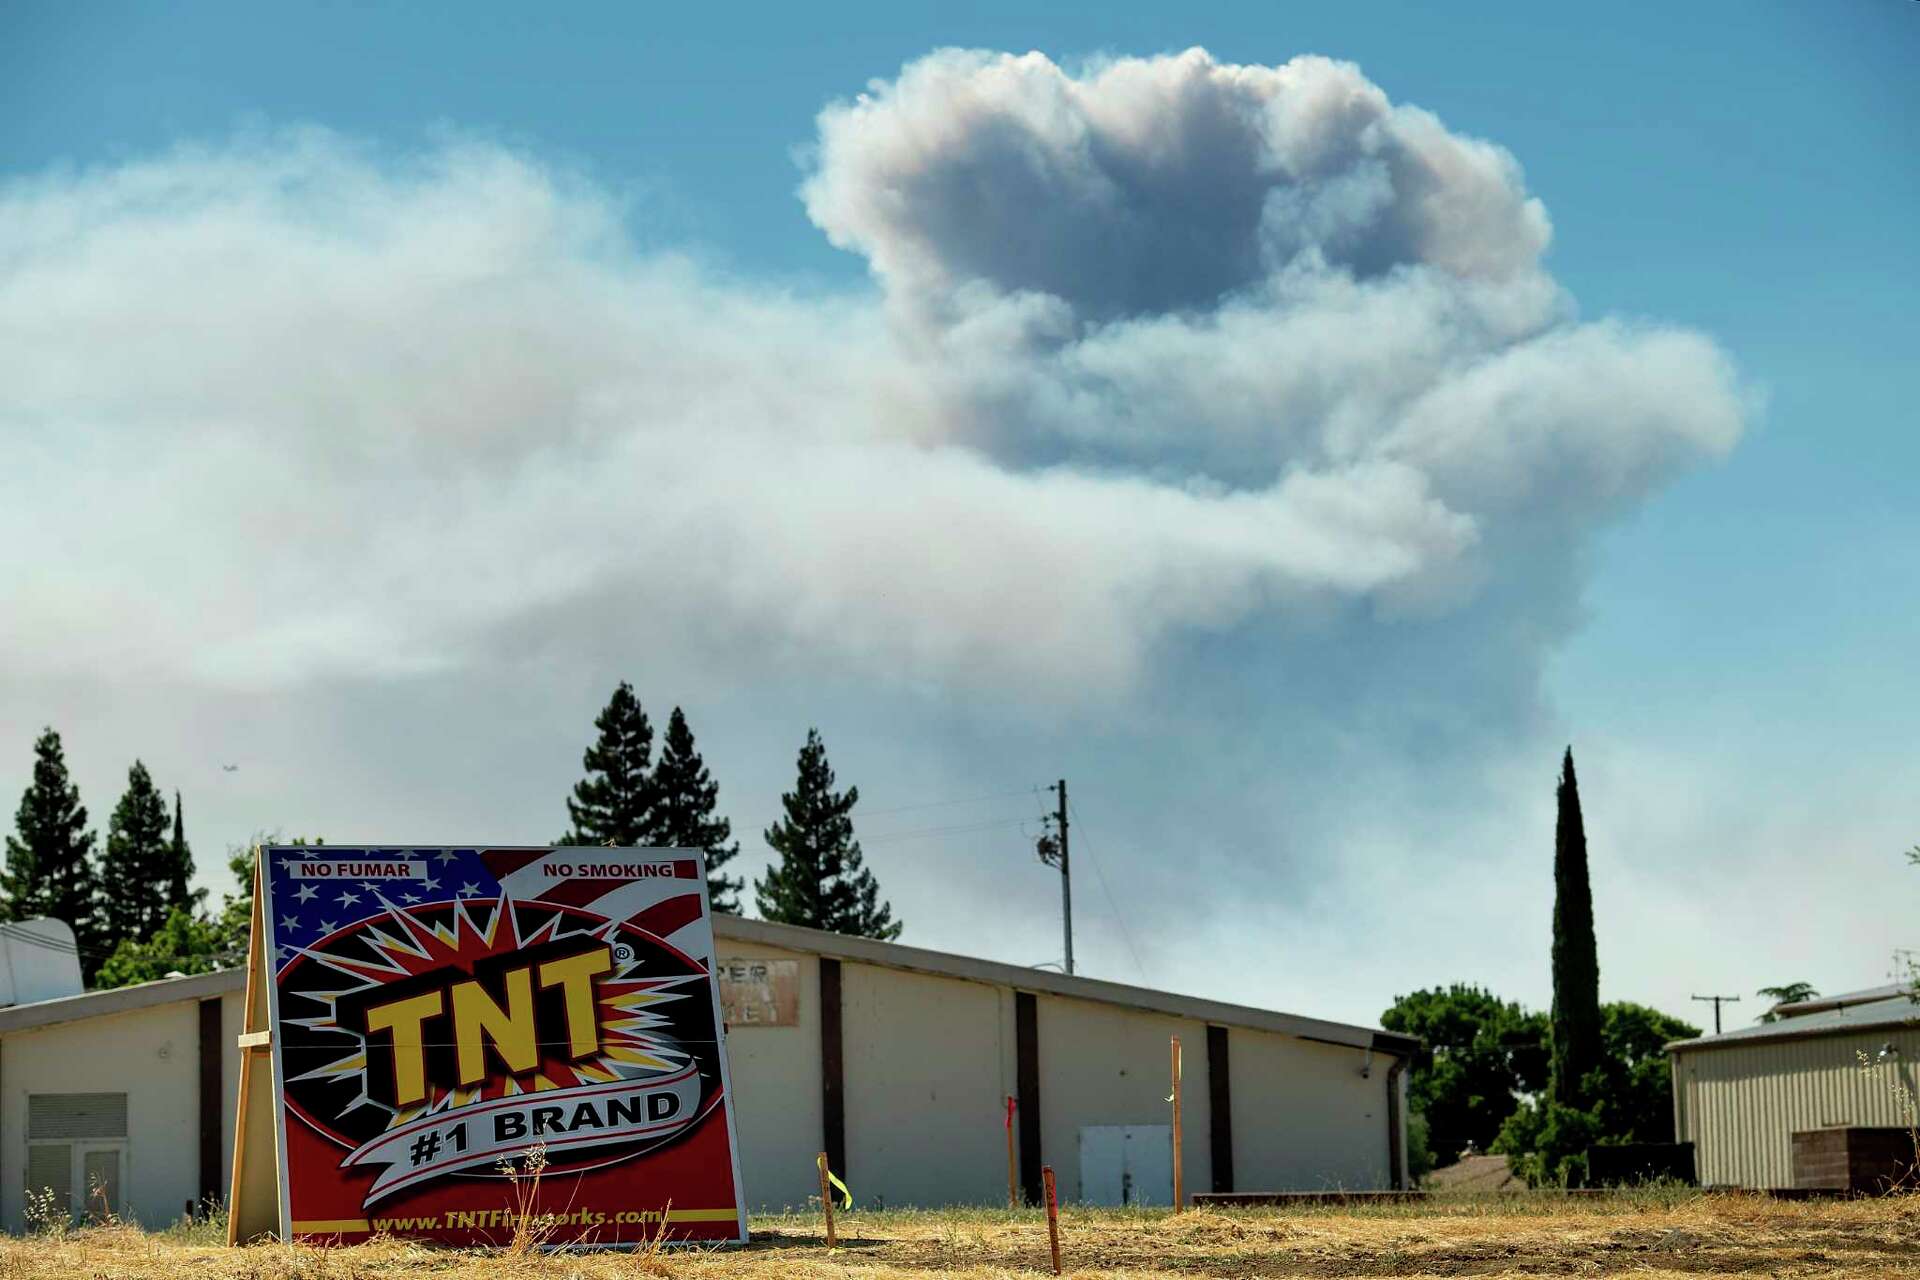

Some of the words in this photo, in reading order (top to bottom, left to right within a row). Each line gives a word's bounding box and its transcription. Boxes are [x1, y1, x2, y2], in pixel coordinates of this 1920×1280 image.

[301, 863, 332, 877] NO
[337, 863, 411, 877] FUMAR
[543, 863, 573, 877] NO
[578, 864, 673, 878] SMOKING
[365, 946, 614, 1107] TNT
[410, 1122, 469, 1167] #1
[493, 1091, 682, 1143] BRAND
[372, 1207, 662, 1231] www.TNTFirorks.com
